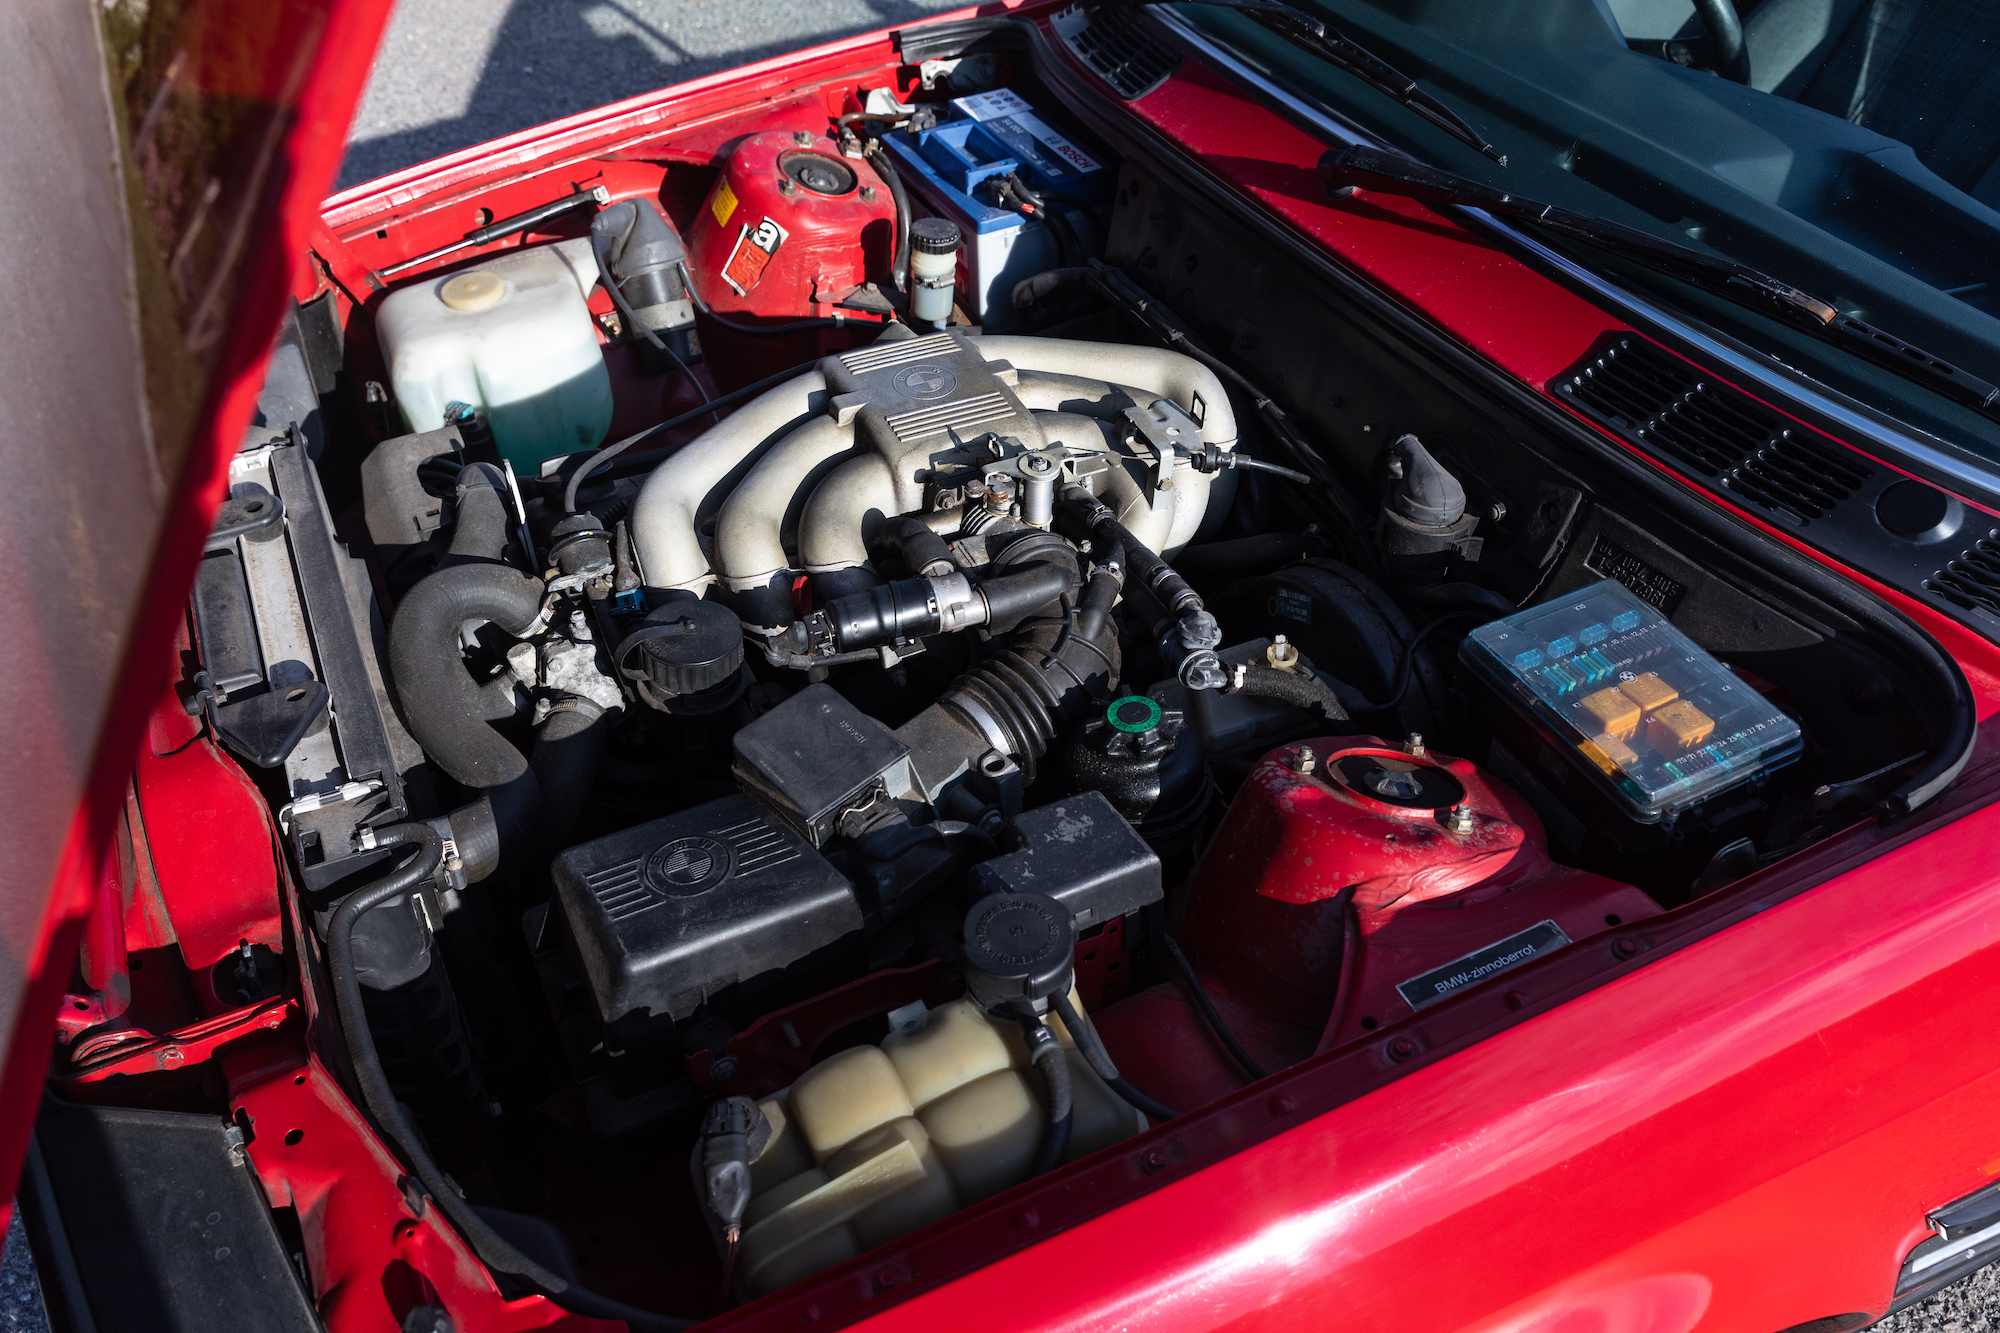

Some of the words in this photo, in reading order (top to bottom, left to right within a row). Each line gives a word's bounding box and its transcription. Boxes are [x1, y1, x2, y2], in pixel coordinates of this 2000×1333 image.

[1057, 145, 1094, 169] BOSCH
[1574, 603, 1586, 612] K10
[1499, 632, 1509, 641] K9
[1611, 637, 1620, 646] 10
[1621, 634, 1629, 642] 11
[1630, 630, 1639, 638] 12
[1649, 623, 1658, 631] 14
[1658, 619, 1667, 627] 15
[1572, 701, 1582, 709] K1
[839, 719, 867, 744] BOSCH
[1645, 716, 1656, 724] K6
[1677, 755, 1687, 765] 20
[1687, 752, 1697, 761] 21
[1698, 747, 1708, 758] 22
[1708, 743, 1717, 752] 23
[1717, 739, 1728, 748] 24
[1727, 735, 1738, 744] 25
[1738, 731, 1748, 739] 26
[1747, 727, 1756, 735] 27
[1755, 723, 1766, 731] 28
[1768, 717, 1777, 726] 29
[1777, 714, 1786, 722] 30
[1434, 943, 1537, 994] BMW-zinnoberrot
